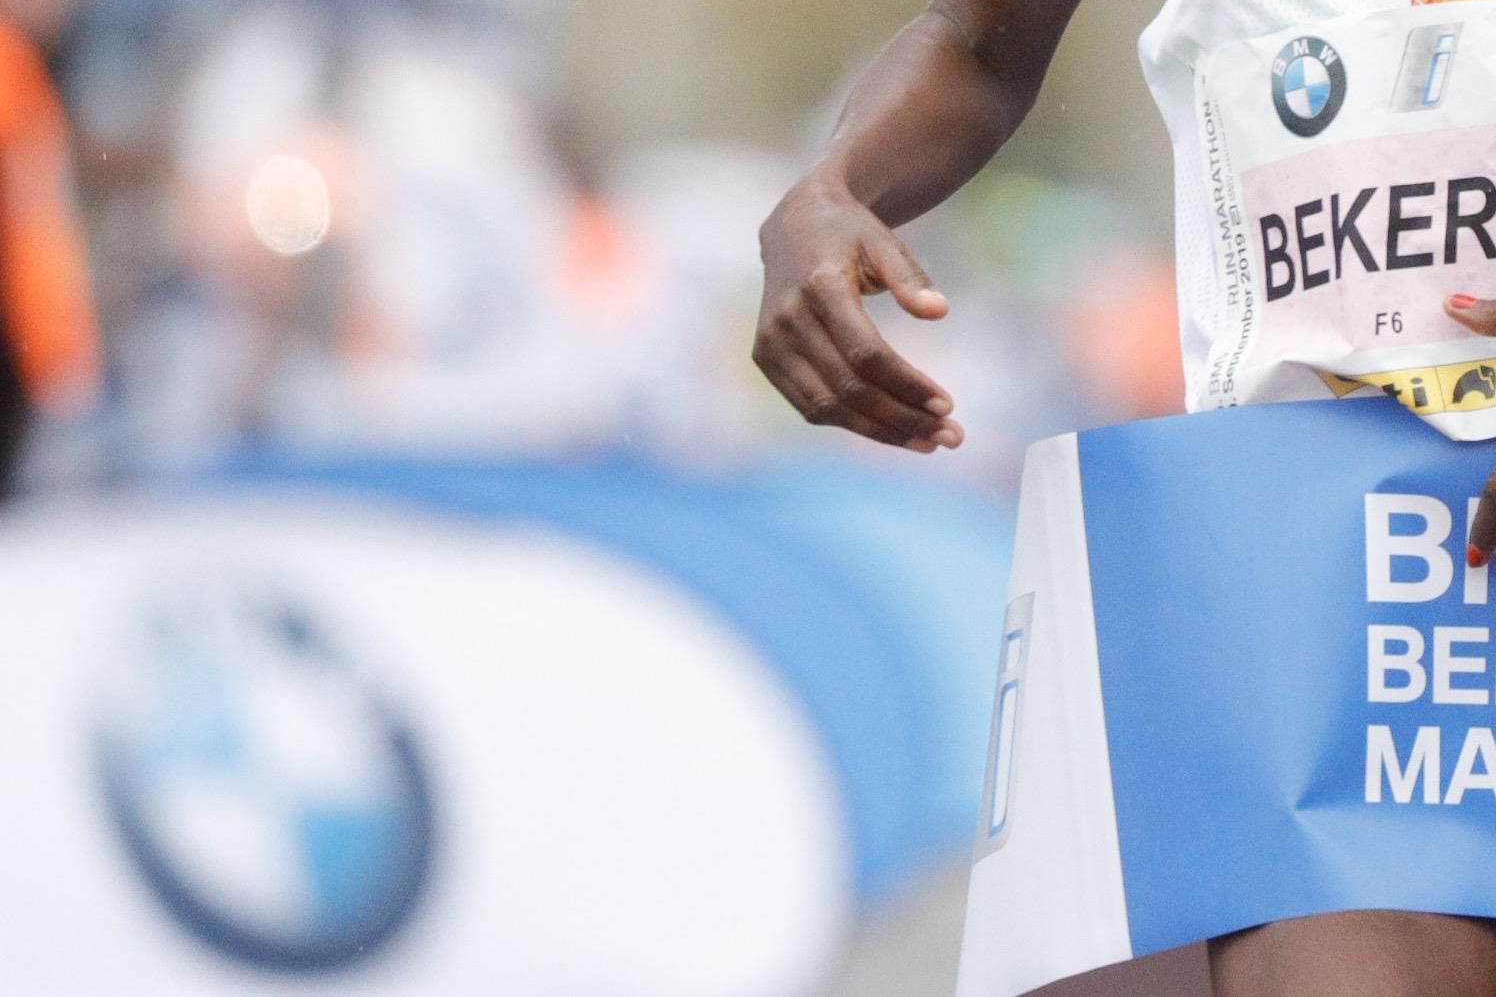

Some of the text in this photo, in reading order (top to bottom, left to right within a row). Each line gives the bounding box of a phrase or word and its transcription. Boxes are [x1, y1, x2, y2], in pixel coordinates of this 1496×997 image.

[1272, 38, 1338, 78] BMW
[1422, 33, 1457, 106] i
[1202, 100, 1240, 321] ERLIN-MARATHON
[1234, 233, 1252, 284] 2019
[1375, 311, 1404, 336] F6
